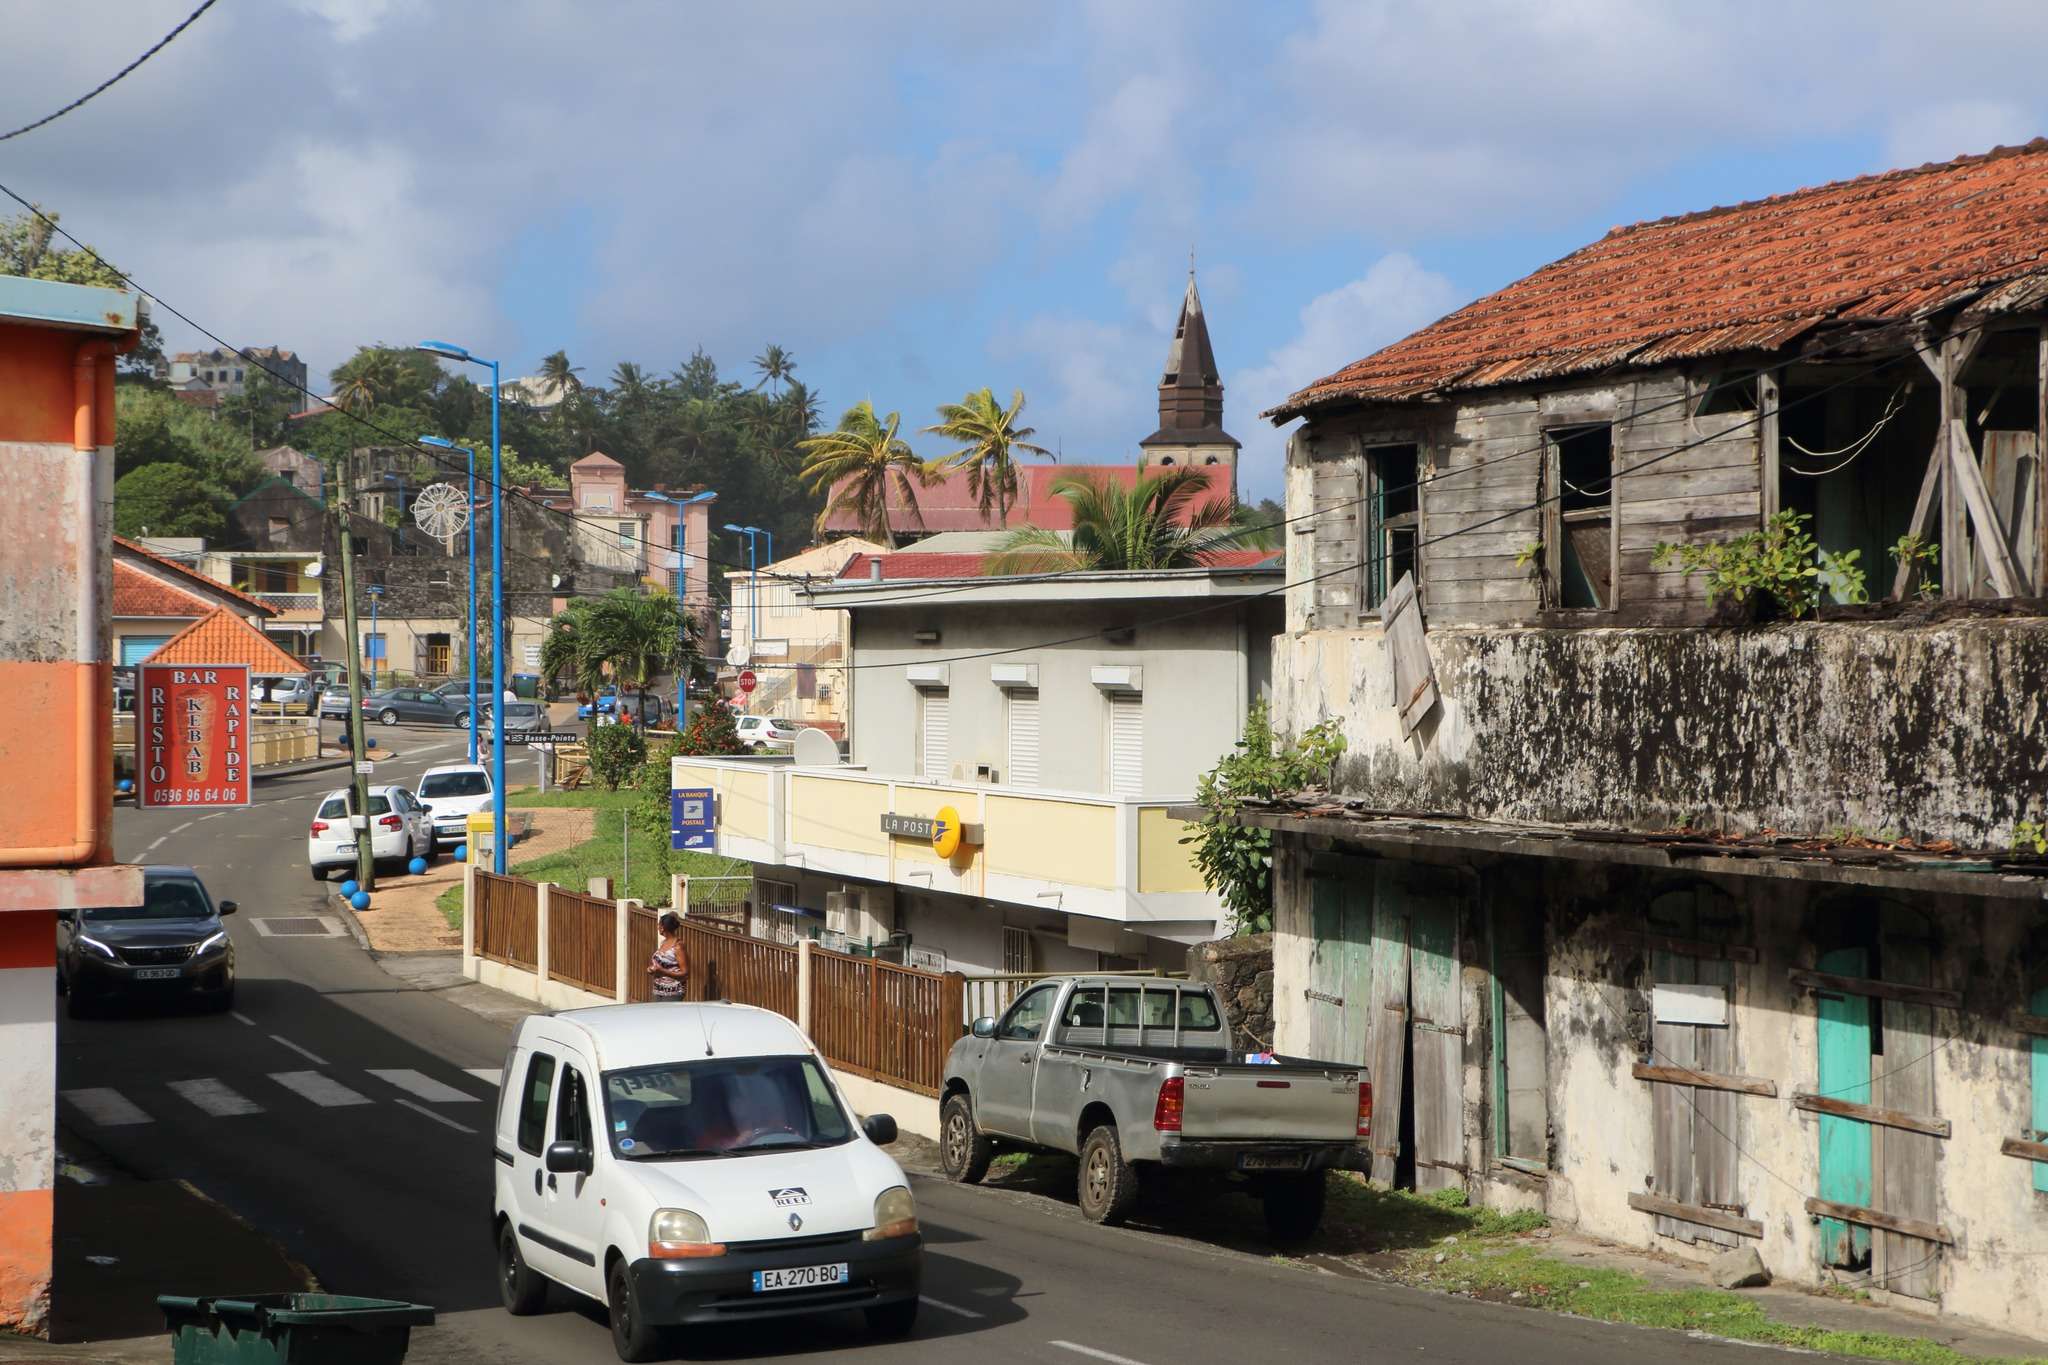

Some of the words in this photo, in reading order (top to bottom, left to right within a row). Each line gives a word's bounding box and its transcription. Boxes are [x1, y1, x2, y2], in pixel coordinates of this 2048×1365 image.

[174, 671, 217, 684] BAR
[740, 678, 756, 686] STOP
[150, 687, 165, 783] RESTO
[186, 697, 202, 775] KEBAB
[226, 686, 240, 782] RAPIDE
[524, 734, 576, 742] Basse-Pointe
[154, 788, 182, 802] 0596
[187, 788, 200, 802] 96
[204, 788, 219, 802] 64
[223, 788, 237, 801] 06
[885, 818, 898, 831] LA
[903, 820, 931, 834] POST
[777, 1196, 808, 1206] REEF
[764, 1265, 839, 1288] EA-270-BQ
